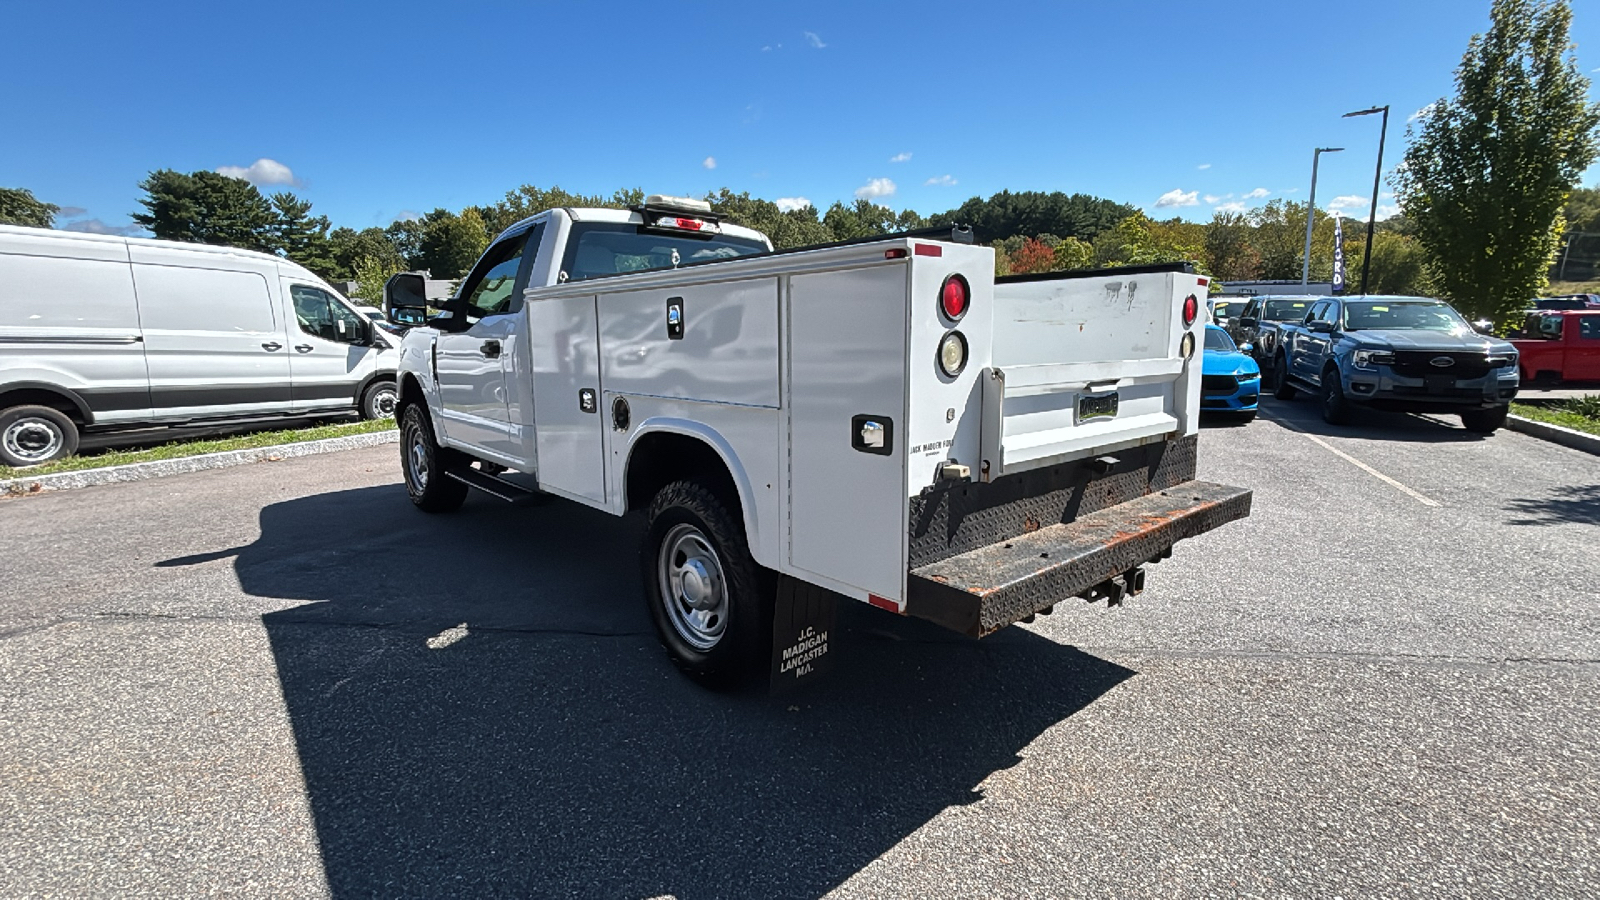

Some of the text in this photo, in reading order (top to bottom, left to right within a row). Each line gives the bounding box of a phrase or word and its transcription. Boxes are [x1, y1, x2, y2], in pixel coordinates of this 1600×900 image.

[797, 626, 816, 641] J.C.
[782, 630, 828, 661] MADIGAN
[780, 643, 828, 673] LANCASTER
[796, 663, 814, 679] MA.
